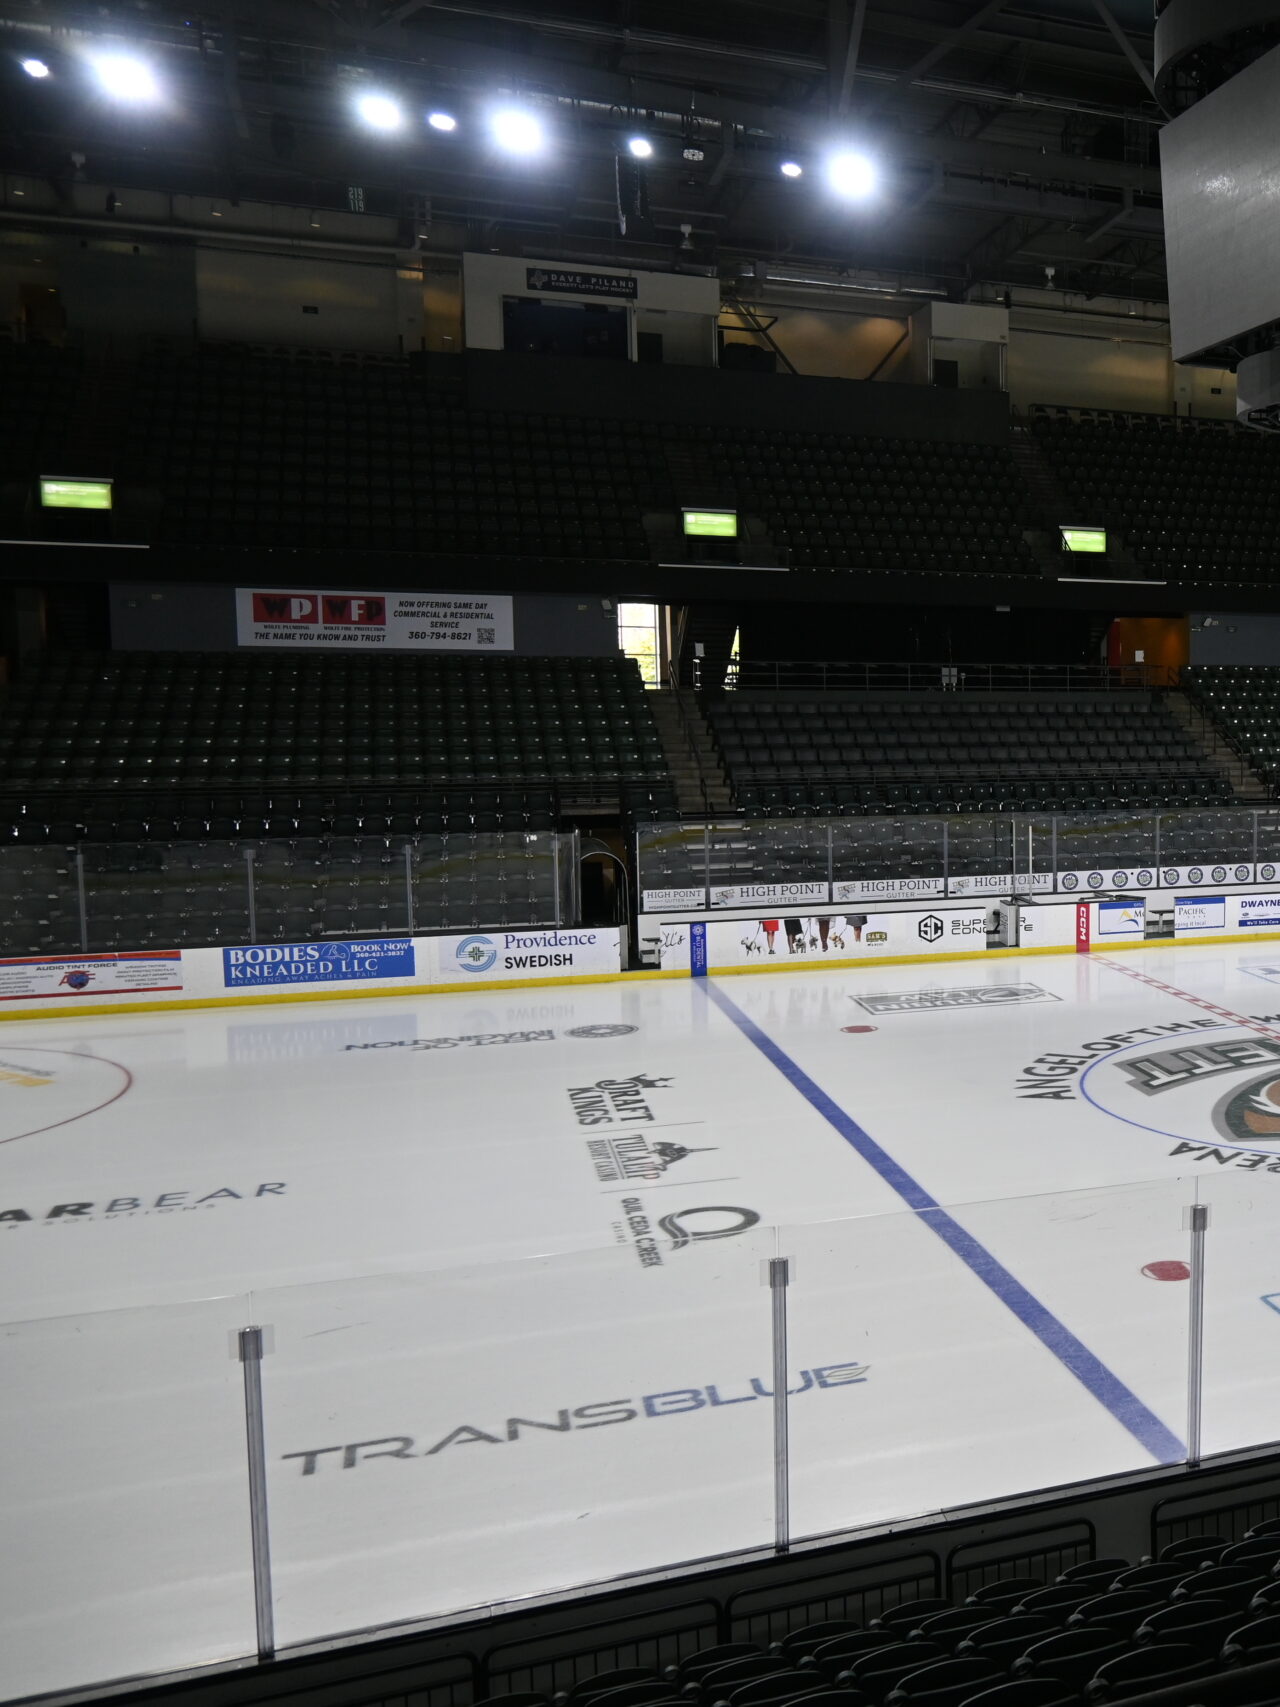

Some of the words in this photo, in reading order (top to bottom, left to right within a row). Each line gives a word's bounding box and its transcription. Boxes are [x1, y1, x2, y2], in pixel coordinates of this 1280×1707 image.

[551, 274, 582, 284] DAVE
[591, 277, 635, 288] PILAND
[416, 601, 452, 609] OFFERING
[393, 610, 441, 618] COMMERCIAL
[449, 612, 494, 620] RESIDENTIAL
[254, 632, 270, 640] THE
[272, 632, 297, 640] NAME
[299, 633, 314, 641] YOU
[317, 633, 341, 641] KNOW
[342, 633, 359, 641] AND
[361, 634, 387, 642] TRUST
[408, 631, 472, 640] 360-794-8621
[861, 881, 895, 893] HIGH
[899, 879, 940, 891] POINT
[974, 877, 1007, 887] HIGH
[646, 891, 671, 899] HIGH
[672, 890, 703, 898] POINT
[740, 885, 776, 898] HIGH
[780, 883, 824, 896] POINT
[886, 891, 915, 899] GUTTER
[767, 896, 798, 904] GUTTER
[1178, 907, 1207, 916] PACIFIC
[1079, 906, 1087, 941] CCM
[350, 943, 381, 953] BOOK
[383, 942, 410, 951] NOW
[504, 931, 596, 950] Providence
[229, 945, 320, 965] BODIES
[504, 953, 573, 969] SWEDISH
[231, 961, 333, 979] KNEADED
[341, 959, 378, 972] LLC
[231, 976, 281, 985] KNEADING
[314, 972, 344, 981] ACHES
[899, 991, 970, 1001] LAW
[875, 998, 982, 1011] DUBIN
[343, 1029, 554, 1051] IMAGINATION
[410, 1040, 459, 1052] OF
[469, 1032, 556, 1048] DEPT
[567, 1087, 613, 1126] KINGS
[595, 1079, 655, 1122] DRAFT
[586, 1139, 612, 1161] RESORT
[611, 1134, 661, 1180] TULALIP
[593, 1160, 618, 1182] CASINO
[621, 1197, 645, 1215] QUIL
[42, 1203, 216, 1226] SOLUTIONS
[611, 1221, 627, 1244] CASINO
[627, 1215, 652, 1237] CEDA
[281, 1362, 869, 1476] TRANSBLUE
